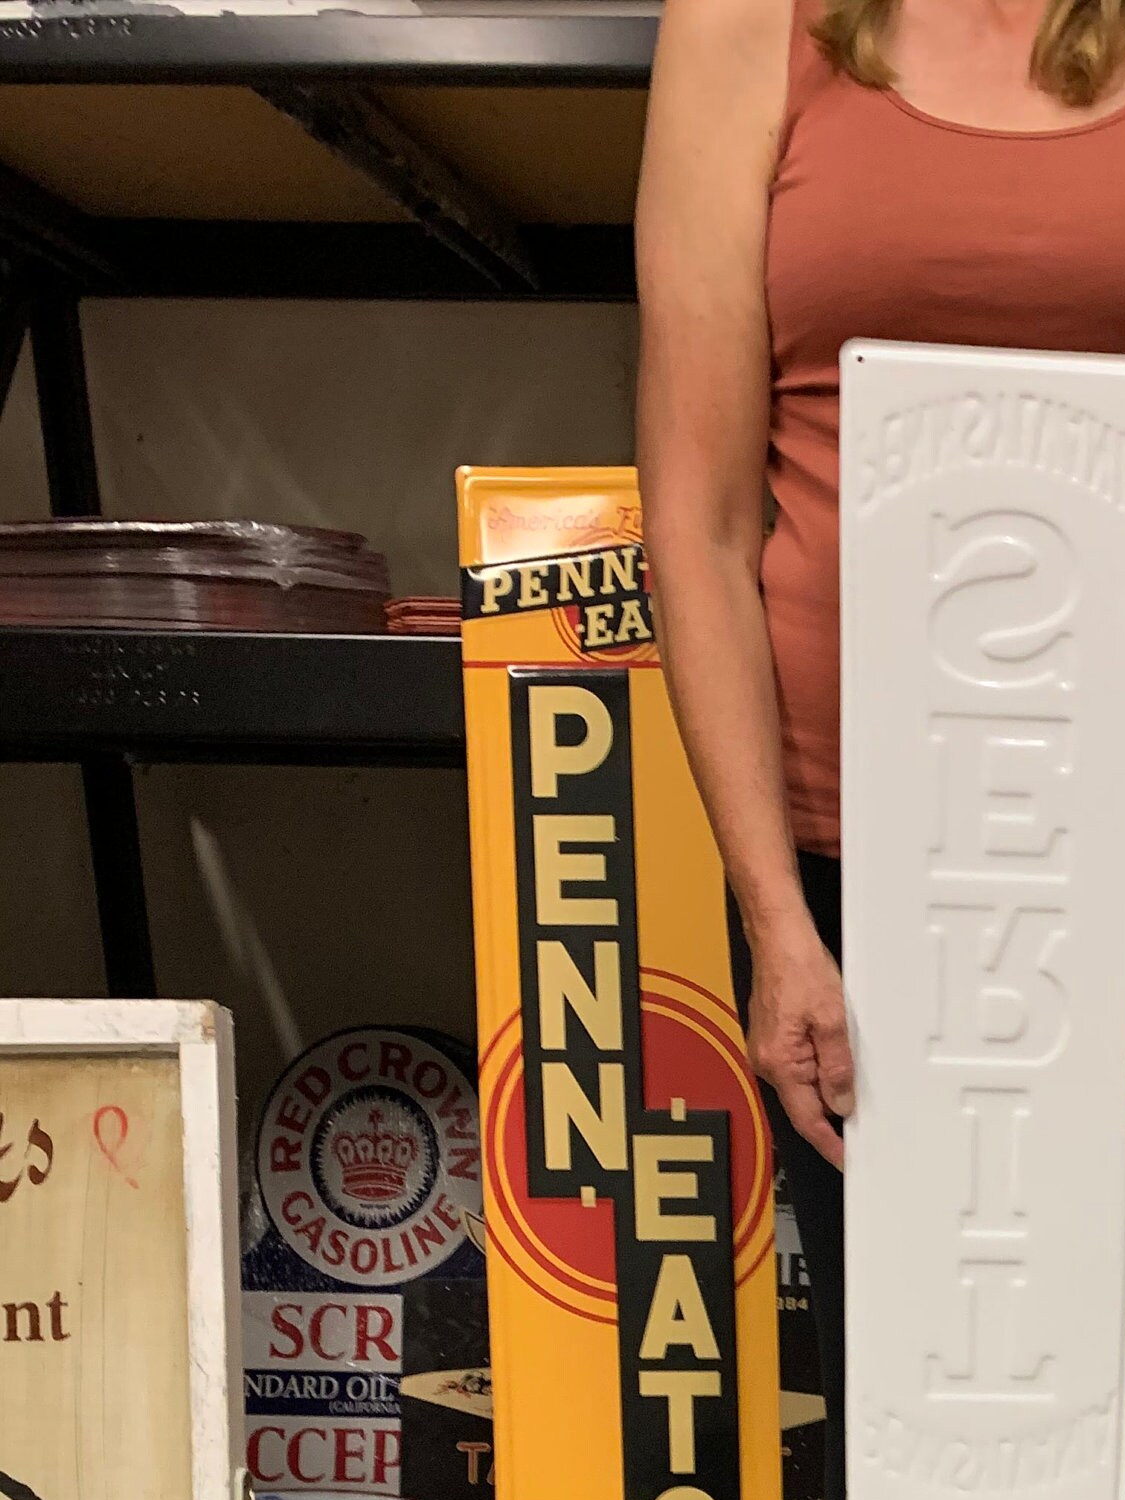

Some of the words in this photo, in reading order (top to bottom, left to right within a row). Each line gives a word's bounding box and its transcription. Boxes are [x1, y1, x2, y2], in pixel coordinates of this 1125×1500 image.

[270, 1065, 332, 1172] RED
[337, 1040, 481, 1182] CROWN
[280, 1192, 463, 1275] GASOLINE
[269, 1303, 399, 1362] SCR
[244, 1373, 340, 1400] NDARD
[346, 1375, 395, 1401] OIL
[246, 1425, 401, 1484] CCEP
